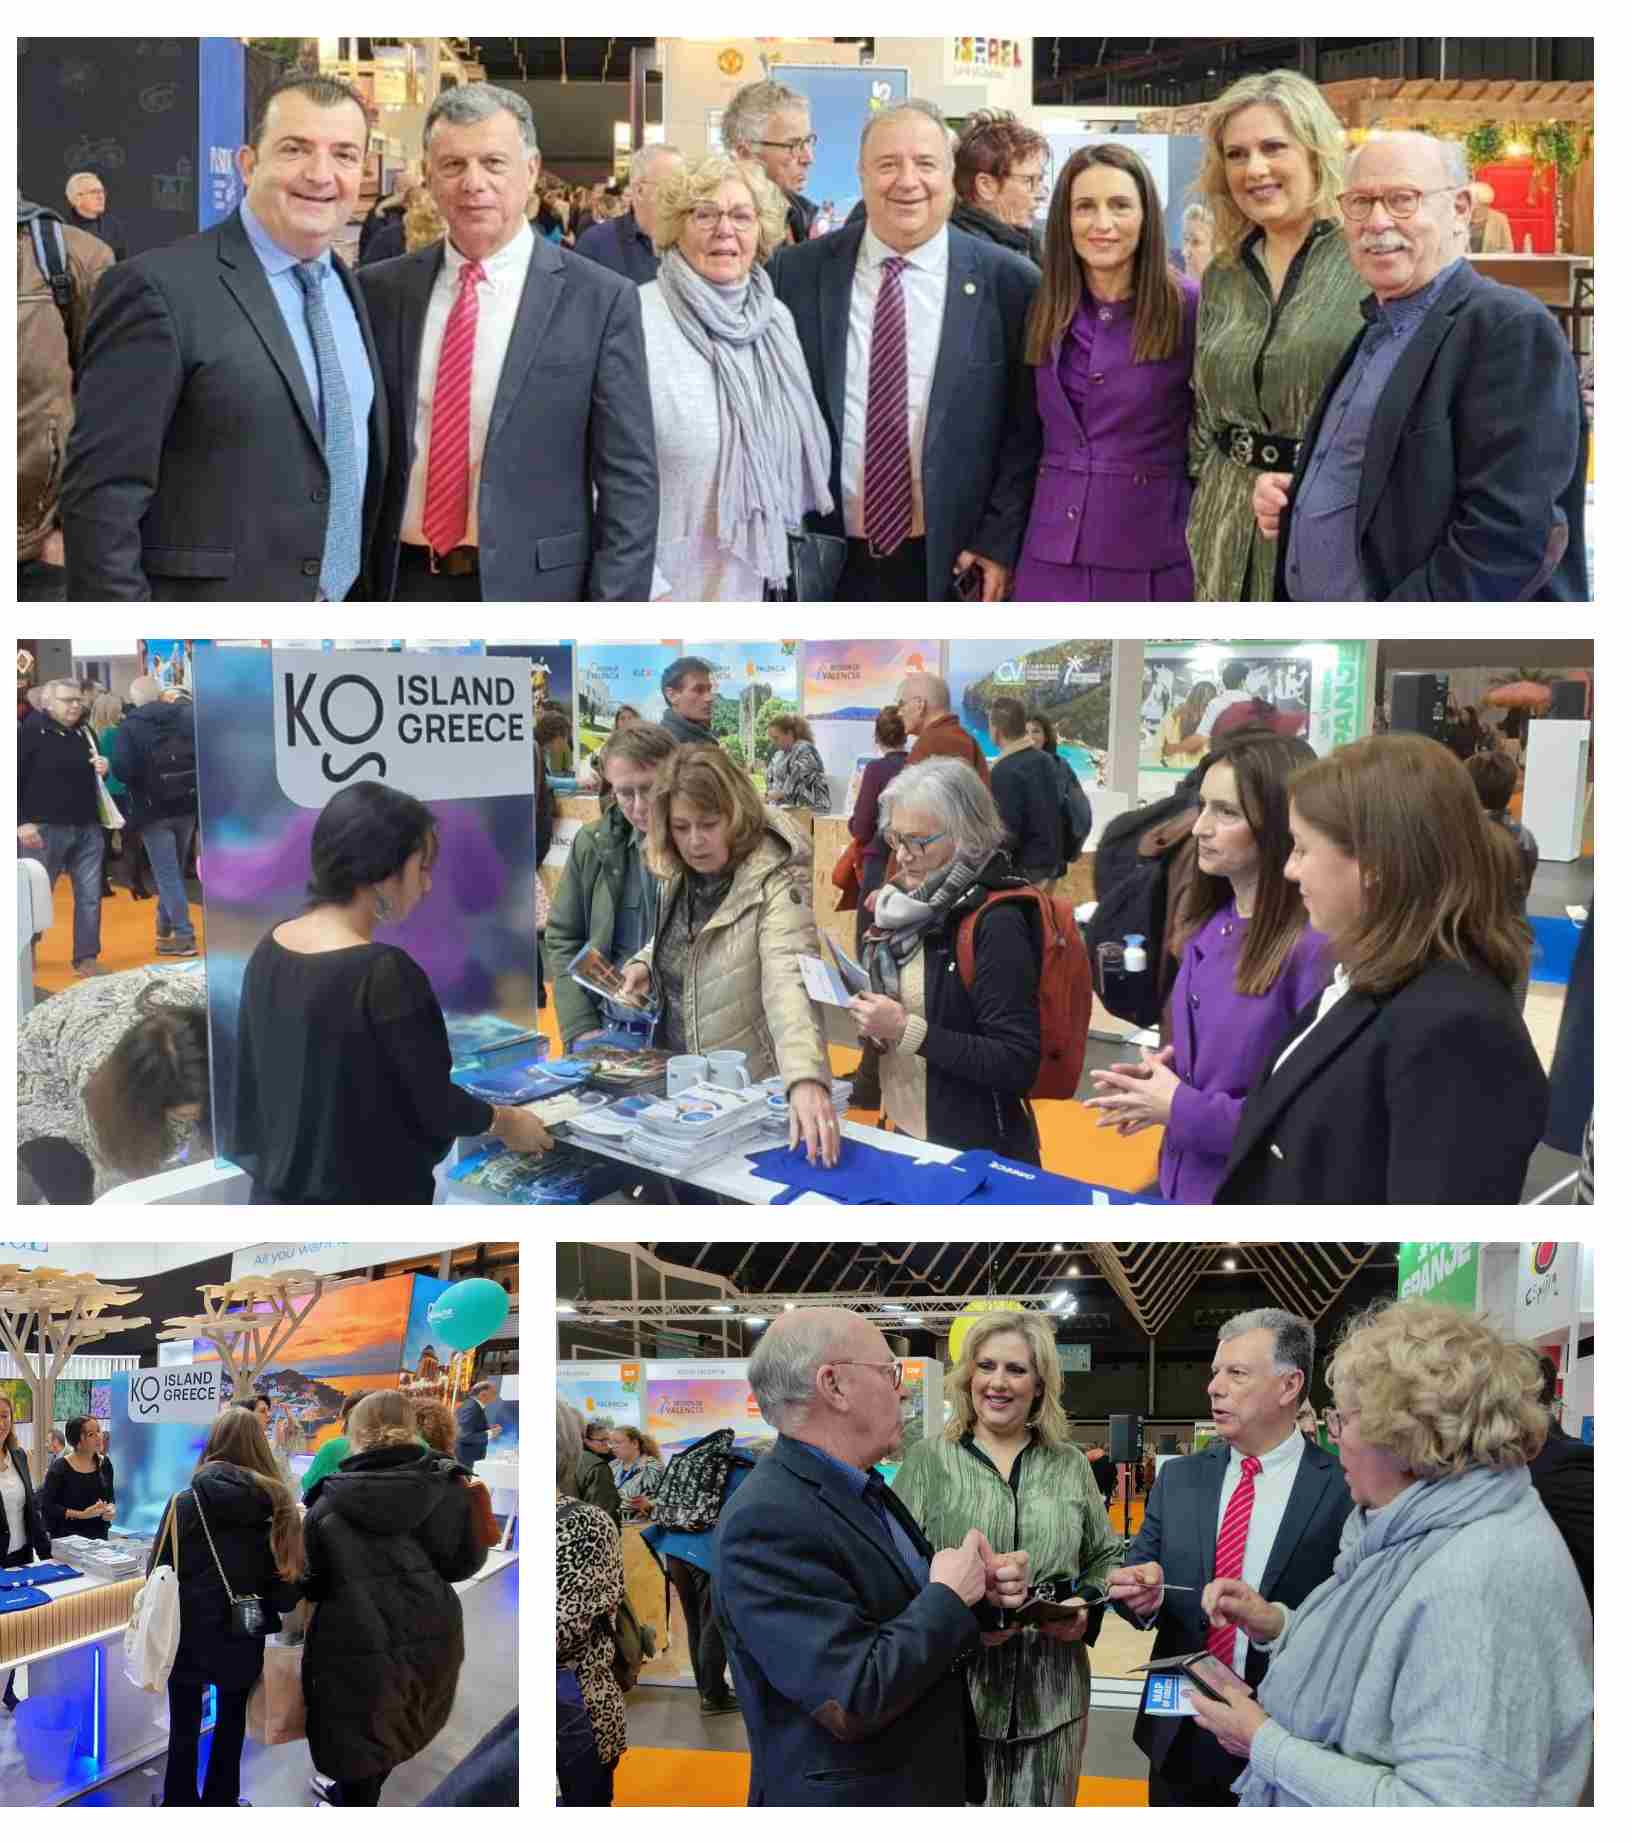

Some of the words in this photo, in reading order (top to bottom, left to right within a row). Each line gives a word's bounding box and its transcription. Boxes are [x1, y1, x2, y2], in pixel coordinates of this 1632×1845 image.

[397, 675, 515, 706] ISLAND
[397, 713, 525, 744] GREECE
[164, 1371, 213, 1387] ISLAND
[163, 1387, 217, 1401] GREECE
